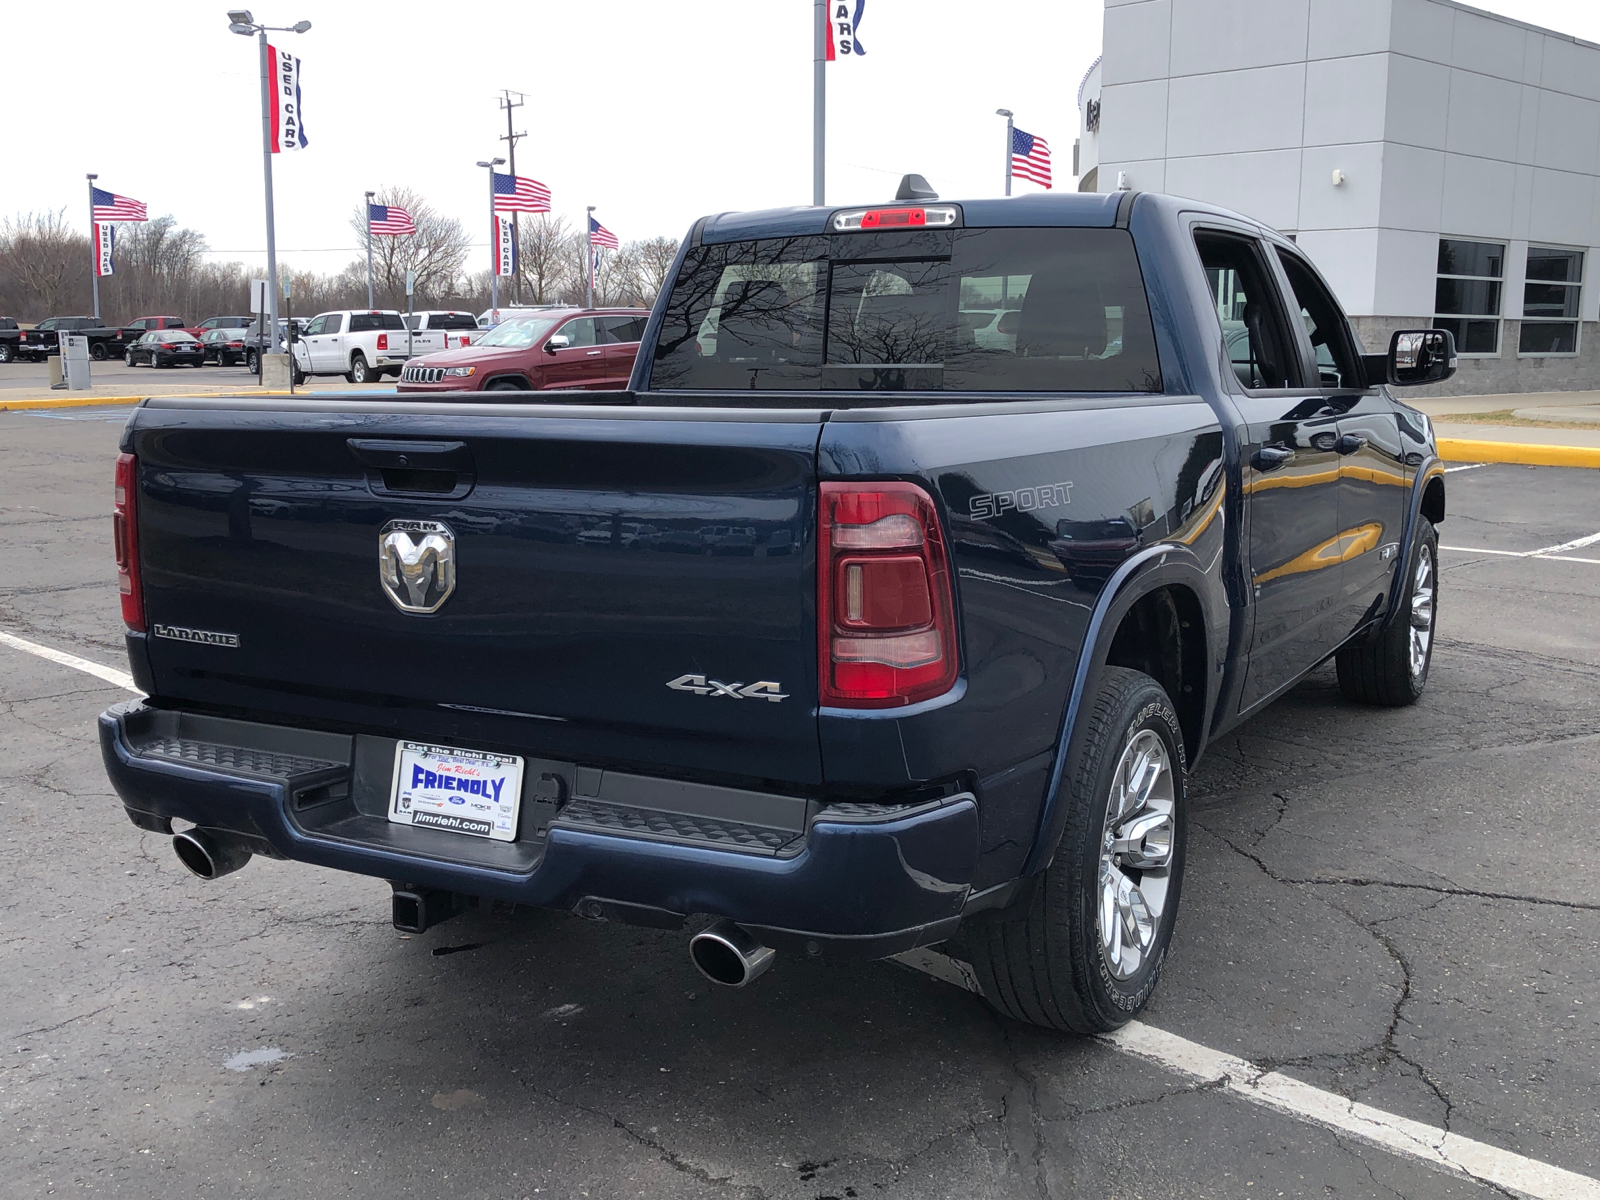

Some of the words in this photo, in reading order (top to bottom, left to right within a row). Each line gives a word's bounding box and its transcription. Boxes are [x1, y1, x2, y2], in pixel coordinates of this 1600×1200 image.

[836, 0, 852, 55] ARS
[281, 52, 293, 96] USED
[284, 104, 296, 148] CARS
[502, 219, 510, 243] USED
[969, 481, 1074, 521] SPORT
[393, 521, 438, 531] RAM
[153, 623, 241, 648] LARAMIE
[407, 743, 428, 752] Get
[431, 746, 450, 755] the
[453, 749, 483, 759] Riehl
[486, 754, 513, 763] Deal
[435, 763, 452, 773] Jim
[453, 765, 481, 776] Riehl's
[411, 762, 507, 804] FRIENDLY
[414, 812, 489, 833] jimriehl.com
